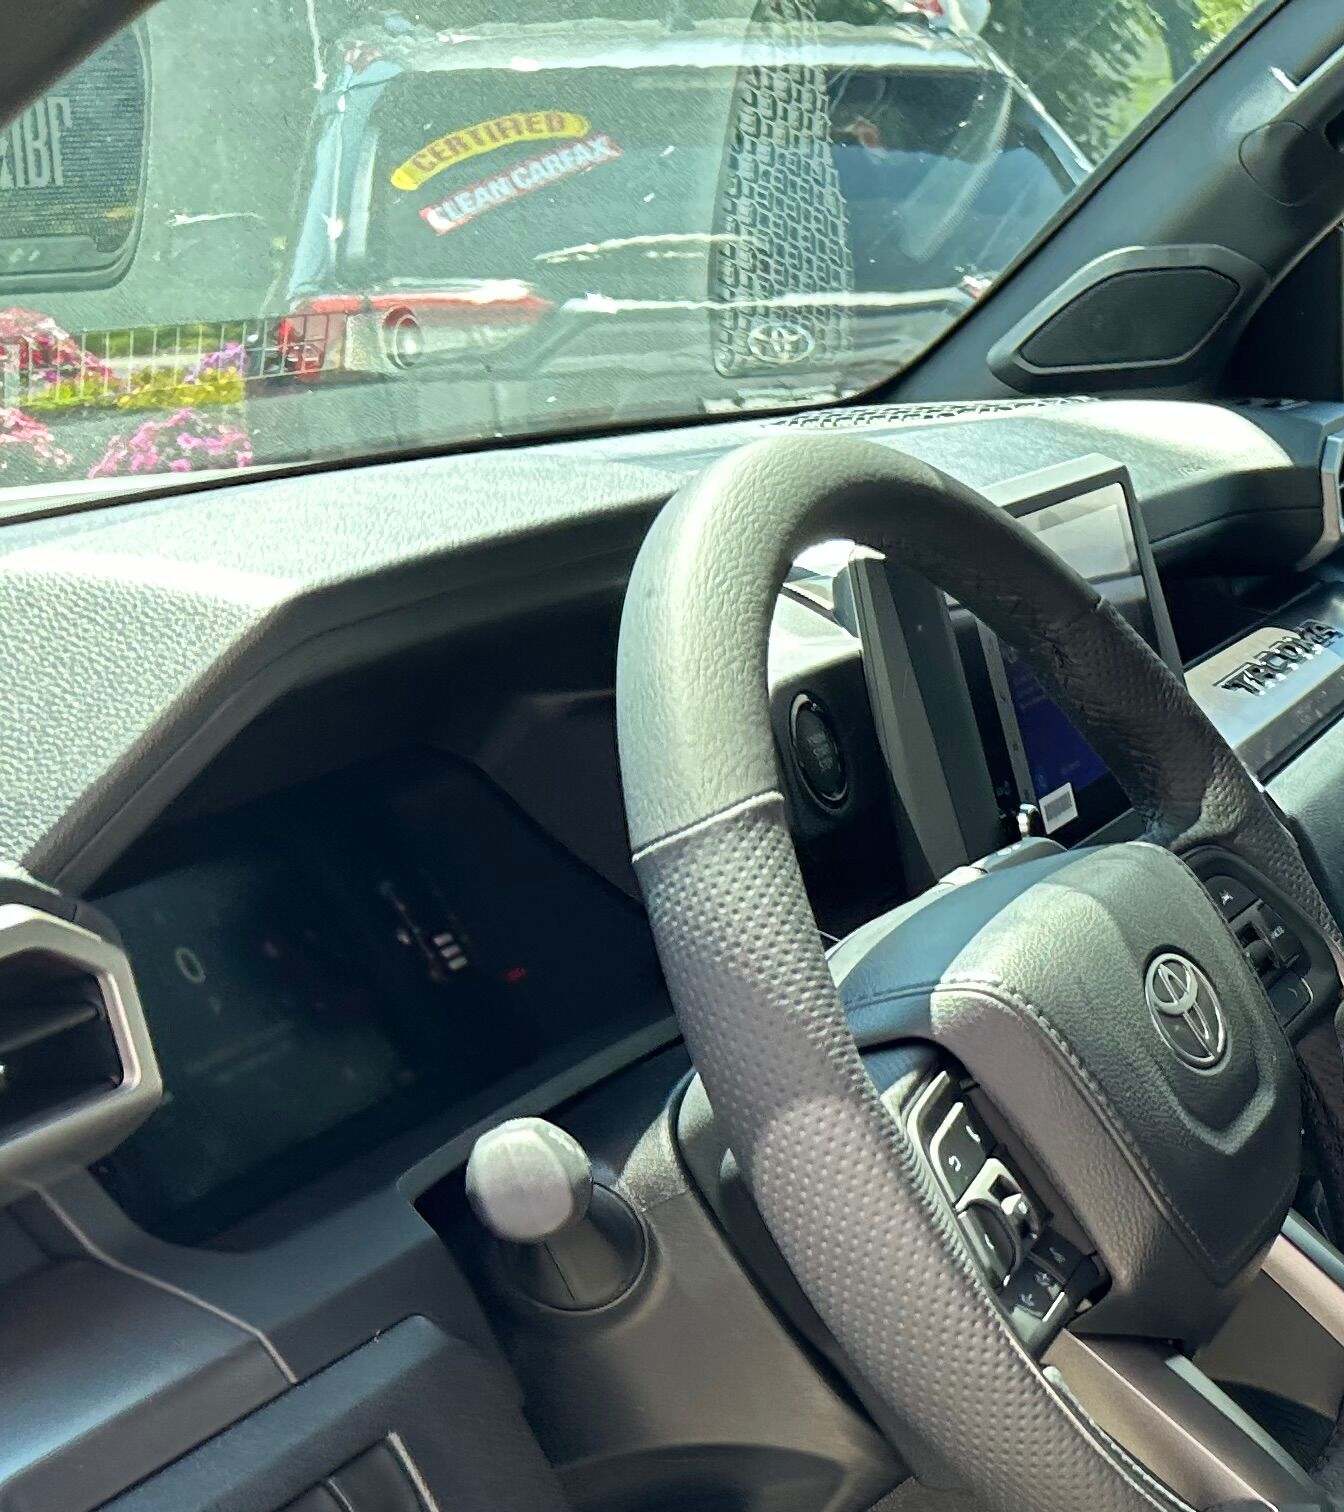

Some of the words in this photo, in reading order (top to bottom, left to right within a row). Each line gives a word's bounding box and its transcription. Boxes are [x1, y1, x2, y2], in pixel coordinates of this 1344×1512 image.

[412, 111, 566, 173] CERTIFIED
[427, 176, 515, 231] CLEAN
[510, 135, 613, 190] CARFAX
[1213, 618, 1344, 697] TACOMA
